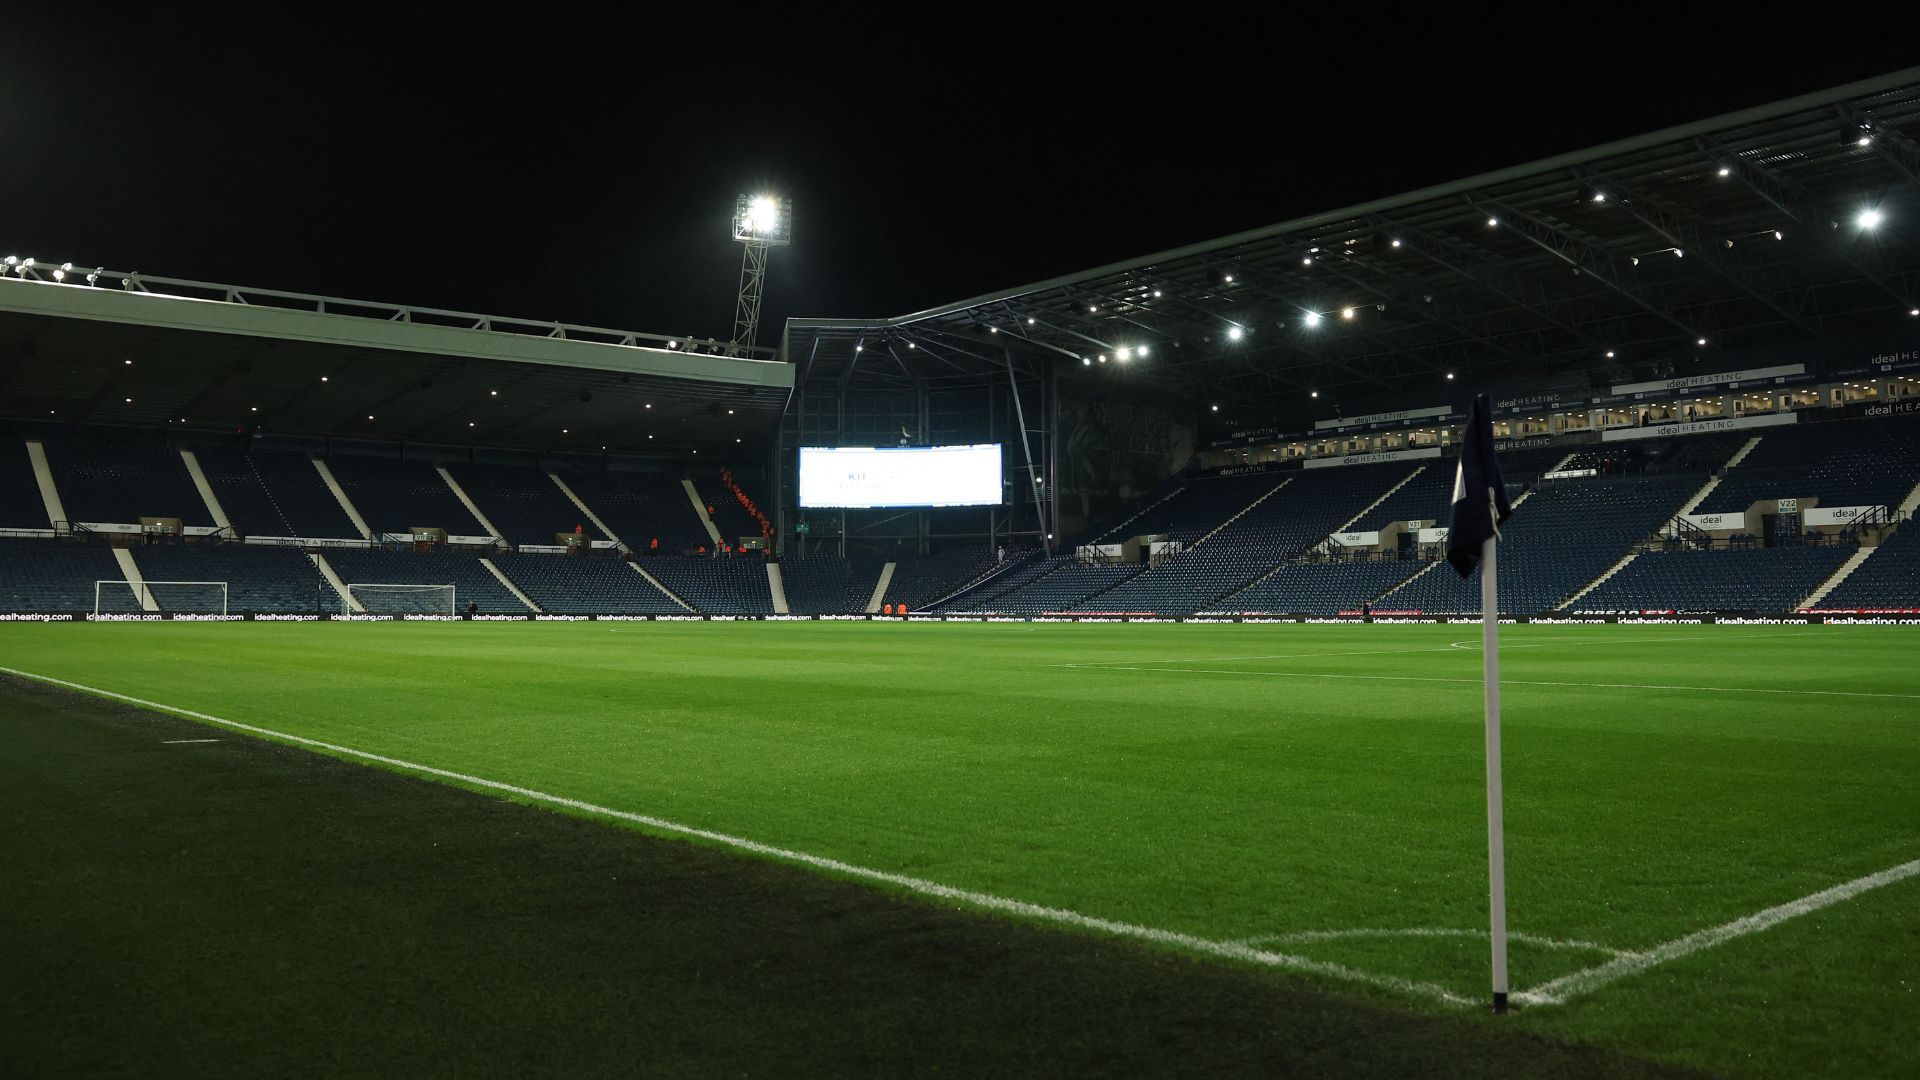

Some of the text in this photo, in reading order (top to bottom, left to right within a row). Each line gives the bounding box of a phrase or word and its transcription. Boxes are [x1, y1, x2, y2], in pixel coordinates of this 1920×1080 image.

[1871, 352, 1899, 365] ideal
[1667, 379, 1689, 389] ideal
[1691, 372, 1742, 385] HEATING
[1496, 398, 1516, 409] ideal
[1517, 394, 1561, 405] HEATING
[1864, 403, 1892, 416] ideal
[1354, 411, 1408, 424] ideal HEATING
[1247, 427, 1279, 437] HEATING
[1657, 420, 1734, 435] ideal HEATING
[1494, 438, 1551, 451] eal HEATING
[1360, 453, 1397, 463] HEATING
[1234, 465, 1267, 475] HEATING
[1832, 508, 1857, 518] ideal
[1700, 515, 1722, 524] ideal
[1346, 533, 1361, 541] ideal
[173, 613, 244, 621] idealheatingcom
[330, 613, 394, 622] idealheating.com
[472, 614, 528, 622] idealheating.com
[535, 614, 590, 622] idealheating.com
[1617, 617, 1702, 625] idealheatingcom
[1714, 617, 1808, 625] idealheatingcom
[1823, 617, 1920, 625] idealheatingcom
